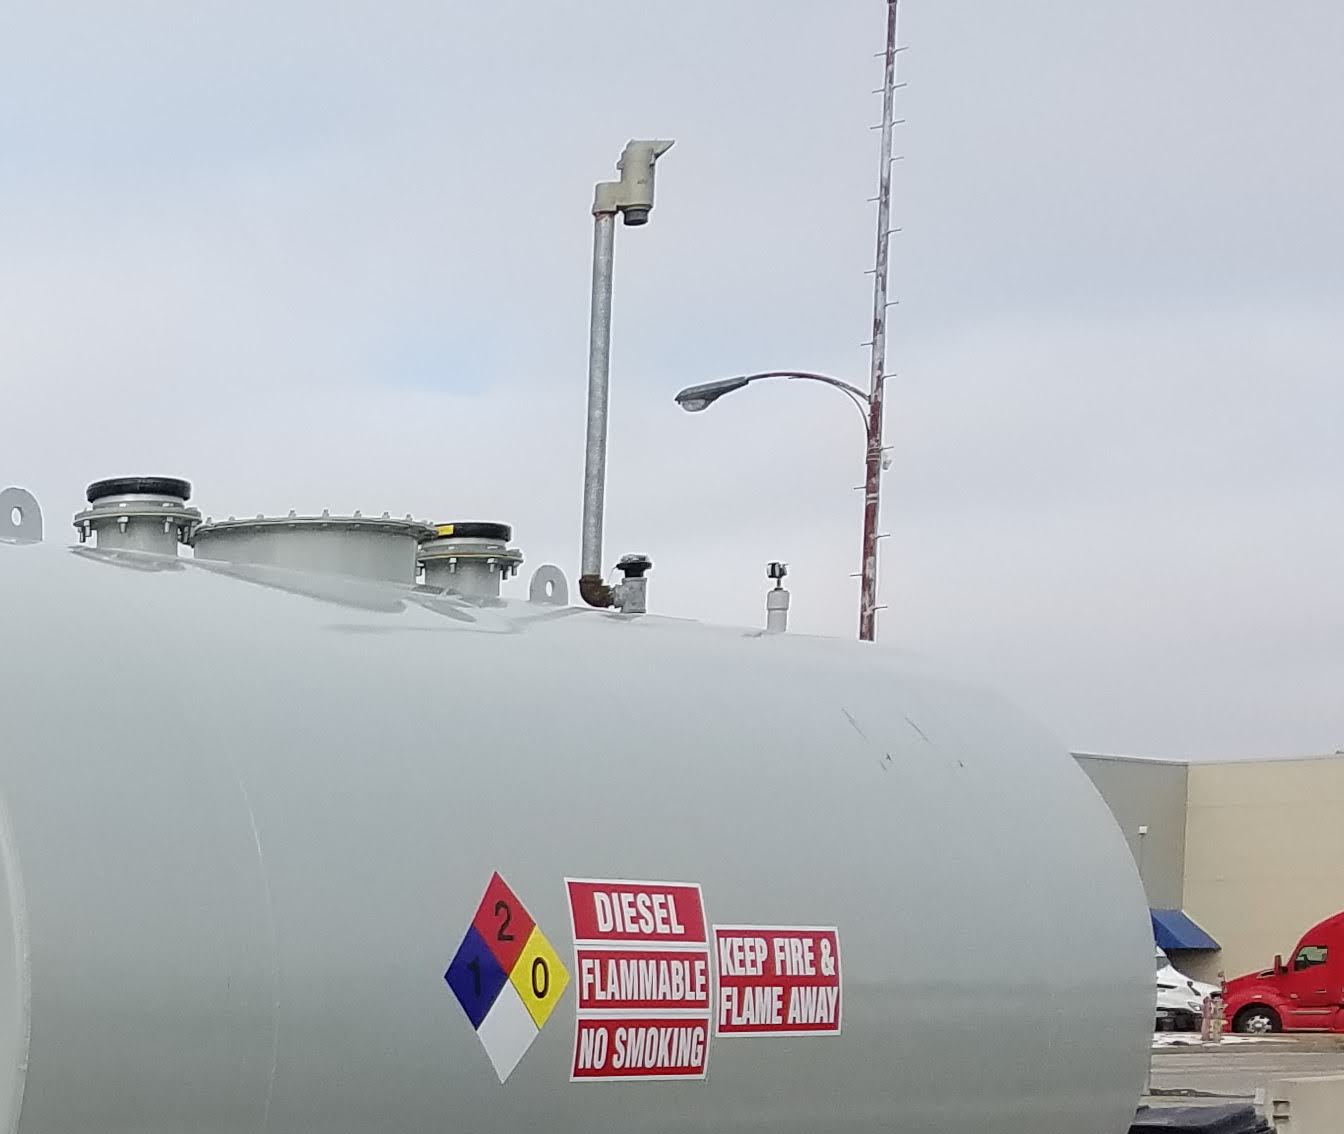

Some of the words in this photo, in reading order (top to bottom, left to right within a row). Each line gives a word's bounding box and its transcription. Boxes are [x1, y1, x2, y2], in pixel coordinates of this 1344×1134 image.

[494, 900, 515, 941] 2
[593, 892, 685, 934] DIESEL
[466, 956, 482, 998] 1
[719, 937, 768, 976] KEEP
[773, 938, 816, 976] FIRE
[820, 938, 835, 976] &
[531, 956, 551, 999] 0
[582, 959, 706, 1000] FLAMMABLE
[720, 986, 783, 1025] FLAME
[787, 986, 838, 1024] AWAY
[578, 1027, 608, 1069] NO
[613, 1027, 705, 1069] SMOKING
